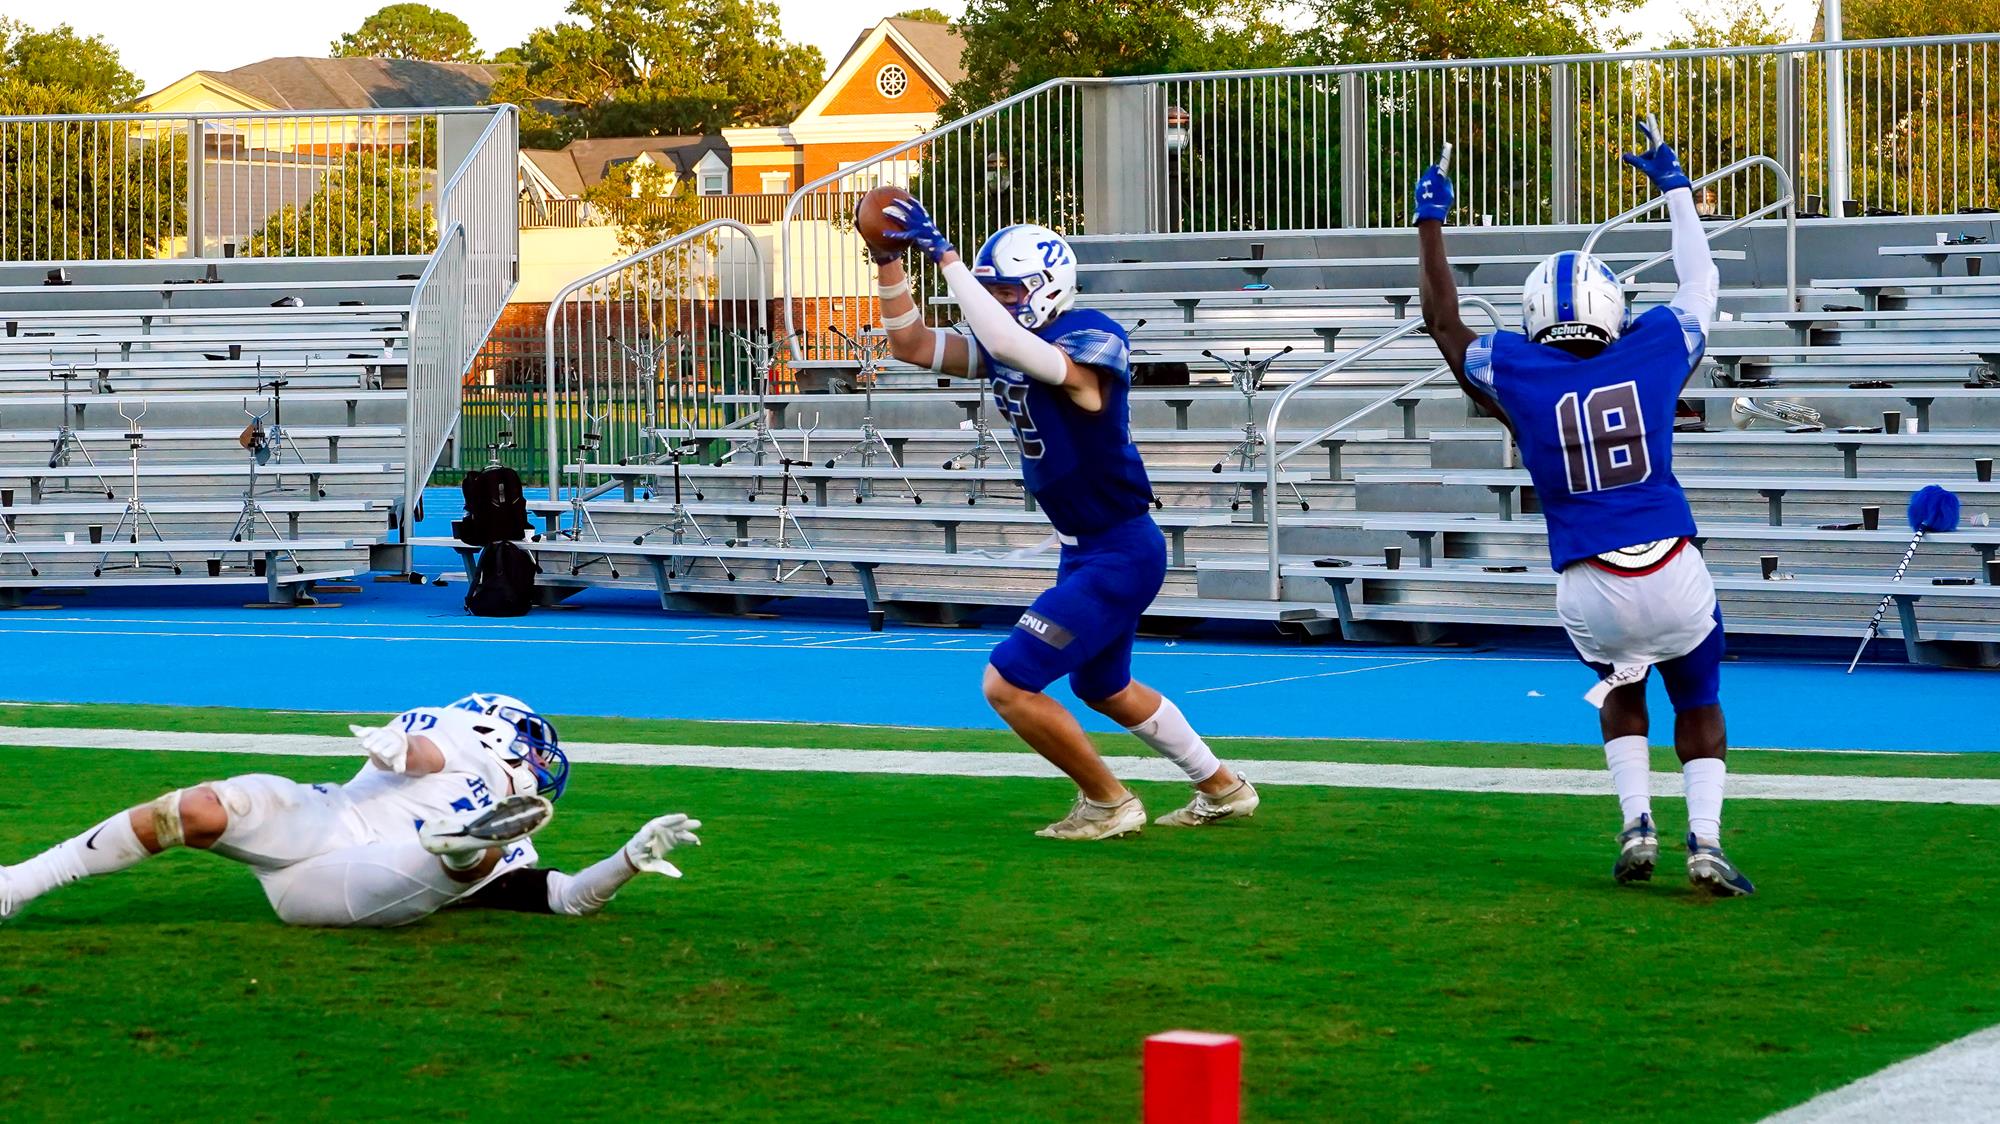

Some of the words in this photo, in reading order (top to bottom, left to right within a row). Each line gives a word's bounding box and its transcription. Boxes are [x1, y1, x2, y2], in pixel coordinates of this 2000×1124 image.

[1037, 239, 1070, 268] 22
[1555, 380, 1652, 495] 18
[1018, 613, 1049, 635] CNU
